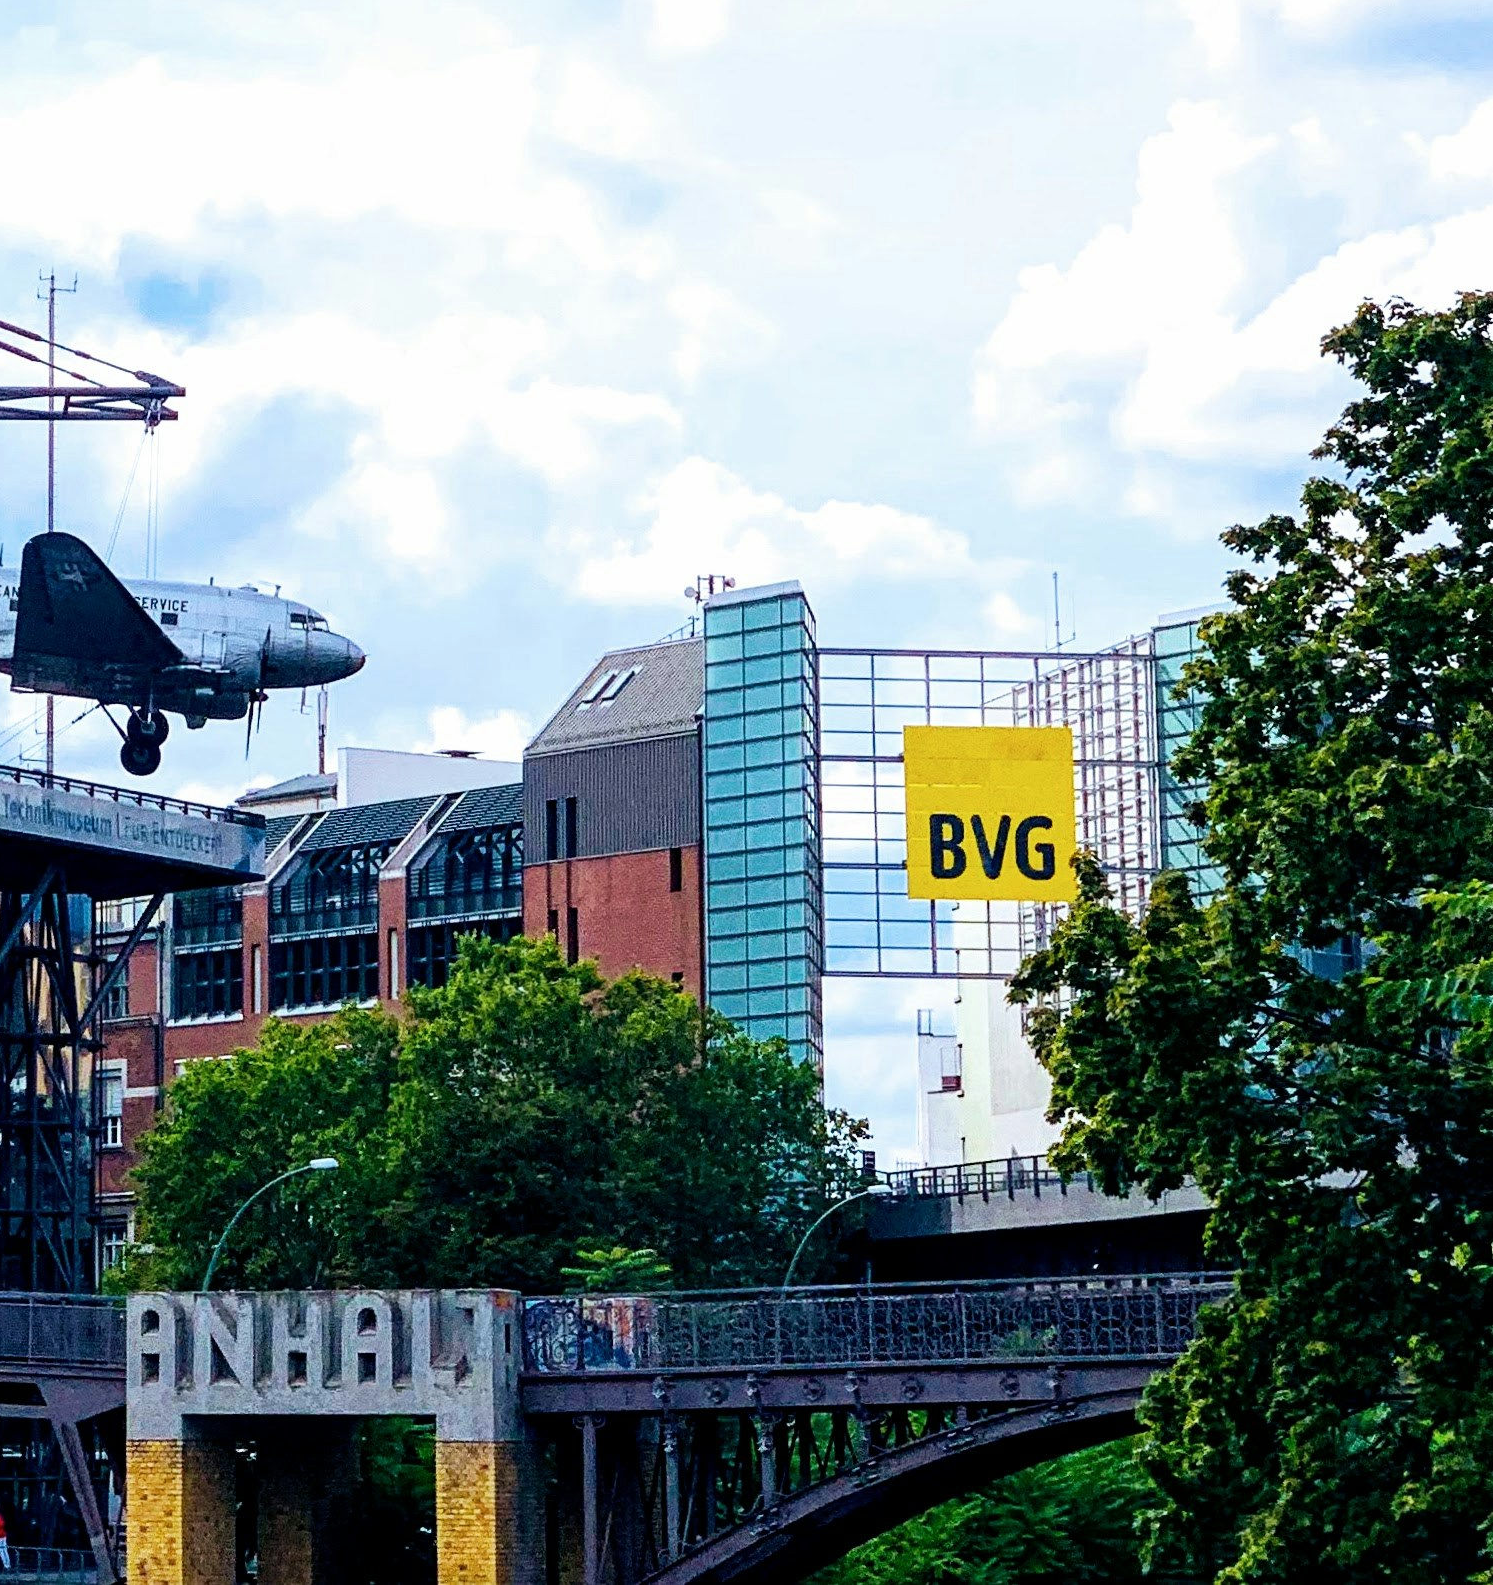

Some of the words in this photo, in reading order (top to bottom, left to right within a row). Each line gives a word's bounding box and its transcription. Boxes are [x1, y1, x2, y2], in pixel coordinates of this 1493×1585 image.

[135, 596, 189, 613] ERVICE
[2, 793, 113, 837] Technikmuseum
[928, 813, 1056, 881] BVG
